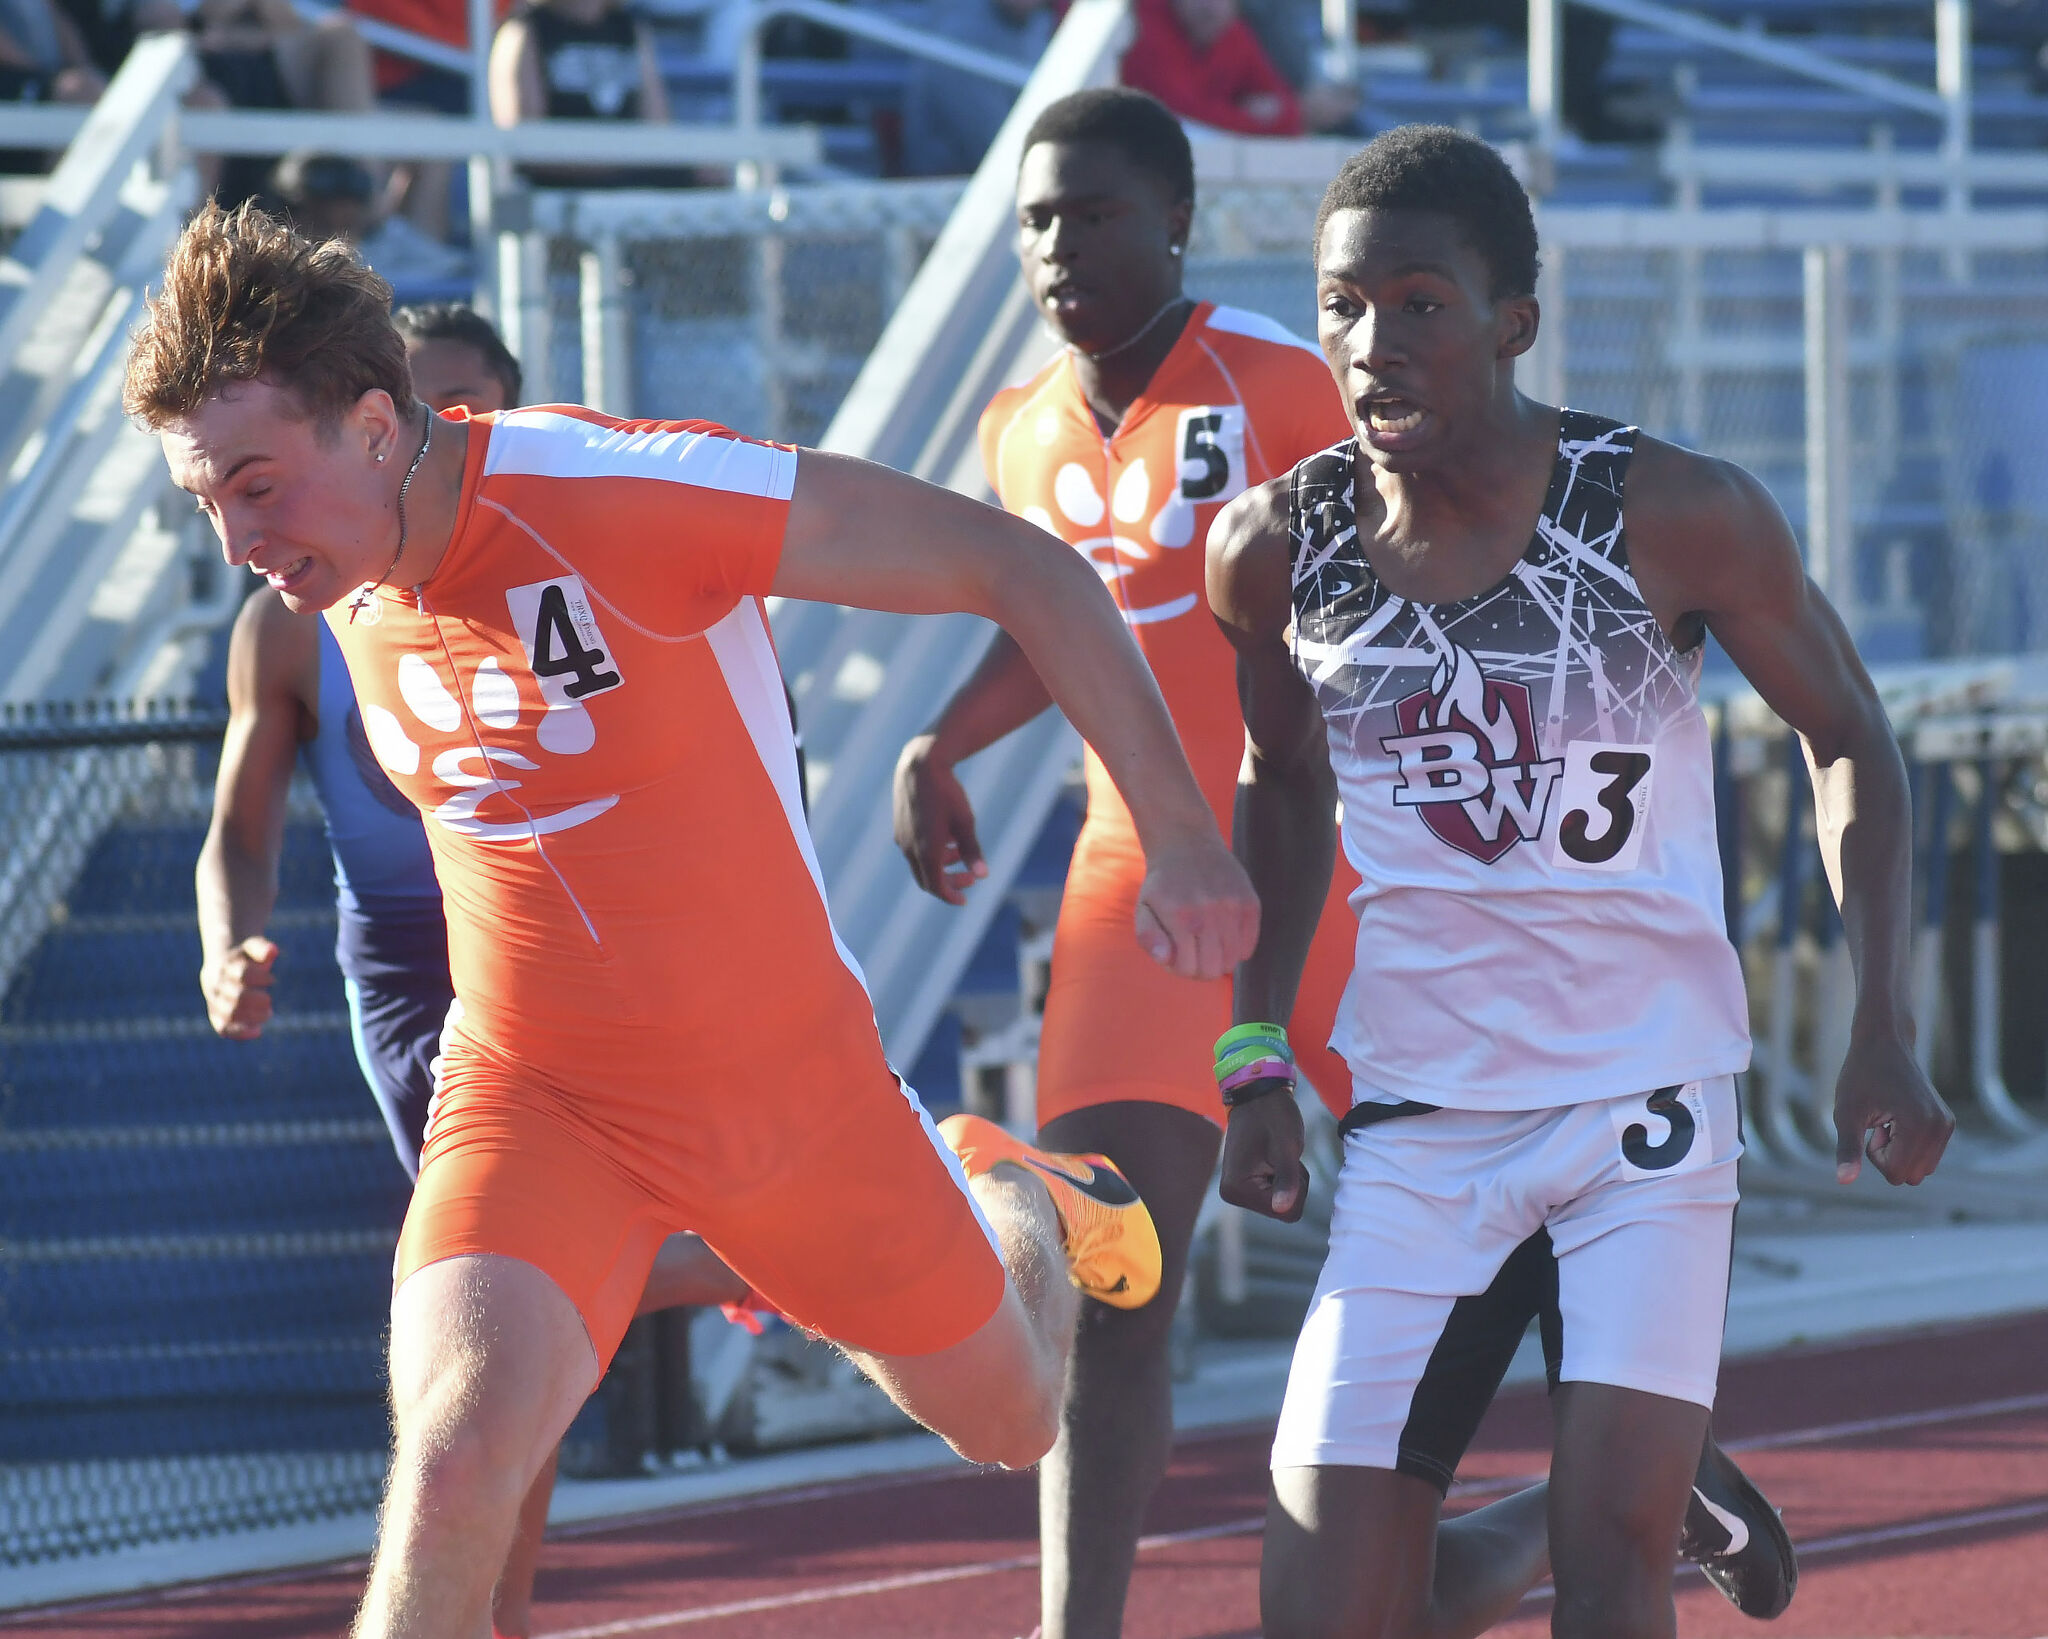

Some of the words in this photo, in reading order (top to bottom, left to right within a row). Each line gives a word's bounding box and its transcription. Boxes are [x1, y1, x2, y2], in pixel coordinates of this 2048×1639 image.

[1181, 414, 1229, 499] 5
[532, 584, 621, 699] 4
[1379, 731, 1565, 842] BW
[1559, 750, 1651, 864] 3
[1621, 1083, 1696, 1171] 3
